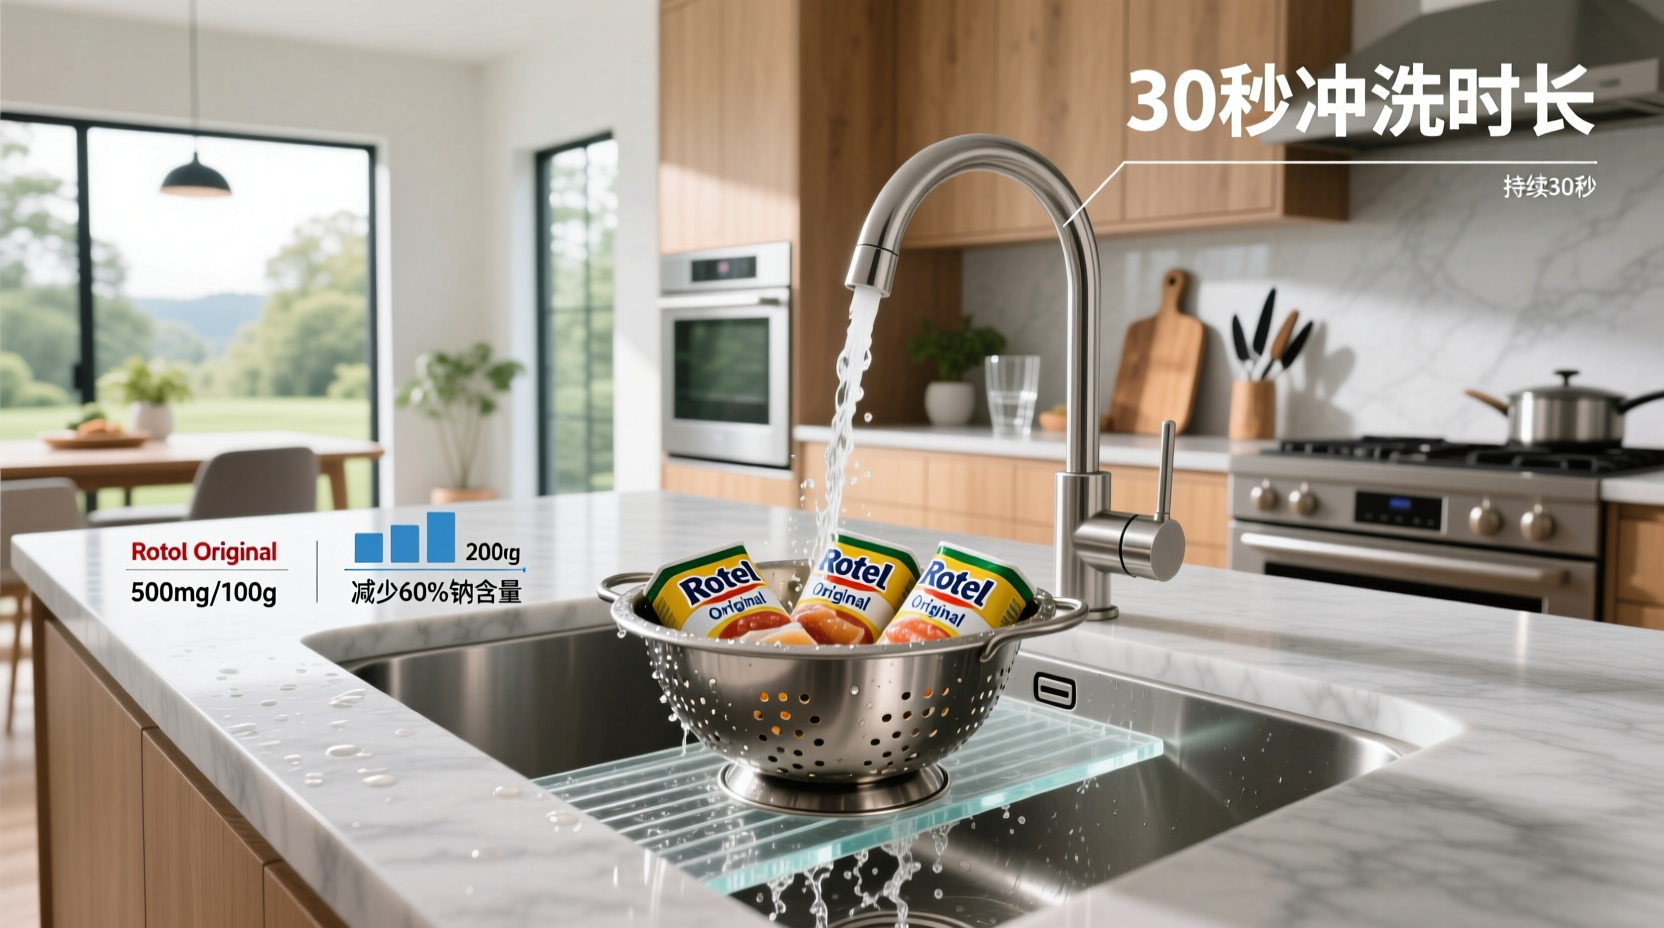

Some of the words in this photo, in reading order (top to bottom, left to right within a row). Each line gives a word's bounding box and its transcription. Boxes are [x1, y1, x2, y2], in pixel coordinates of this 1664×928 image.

[679, 560, 762, 607] Rotel
[818, 548, 894, 591] Rotel
[917, 560, 995, 608] Rotel
[812, 582, 871, 612] Original
